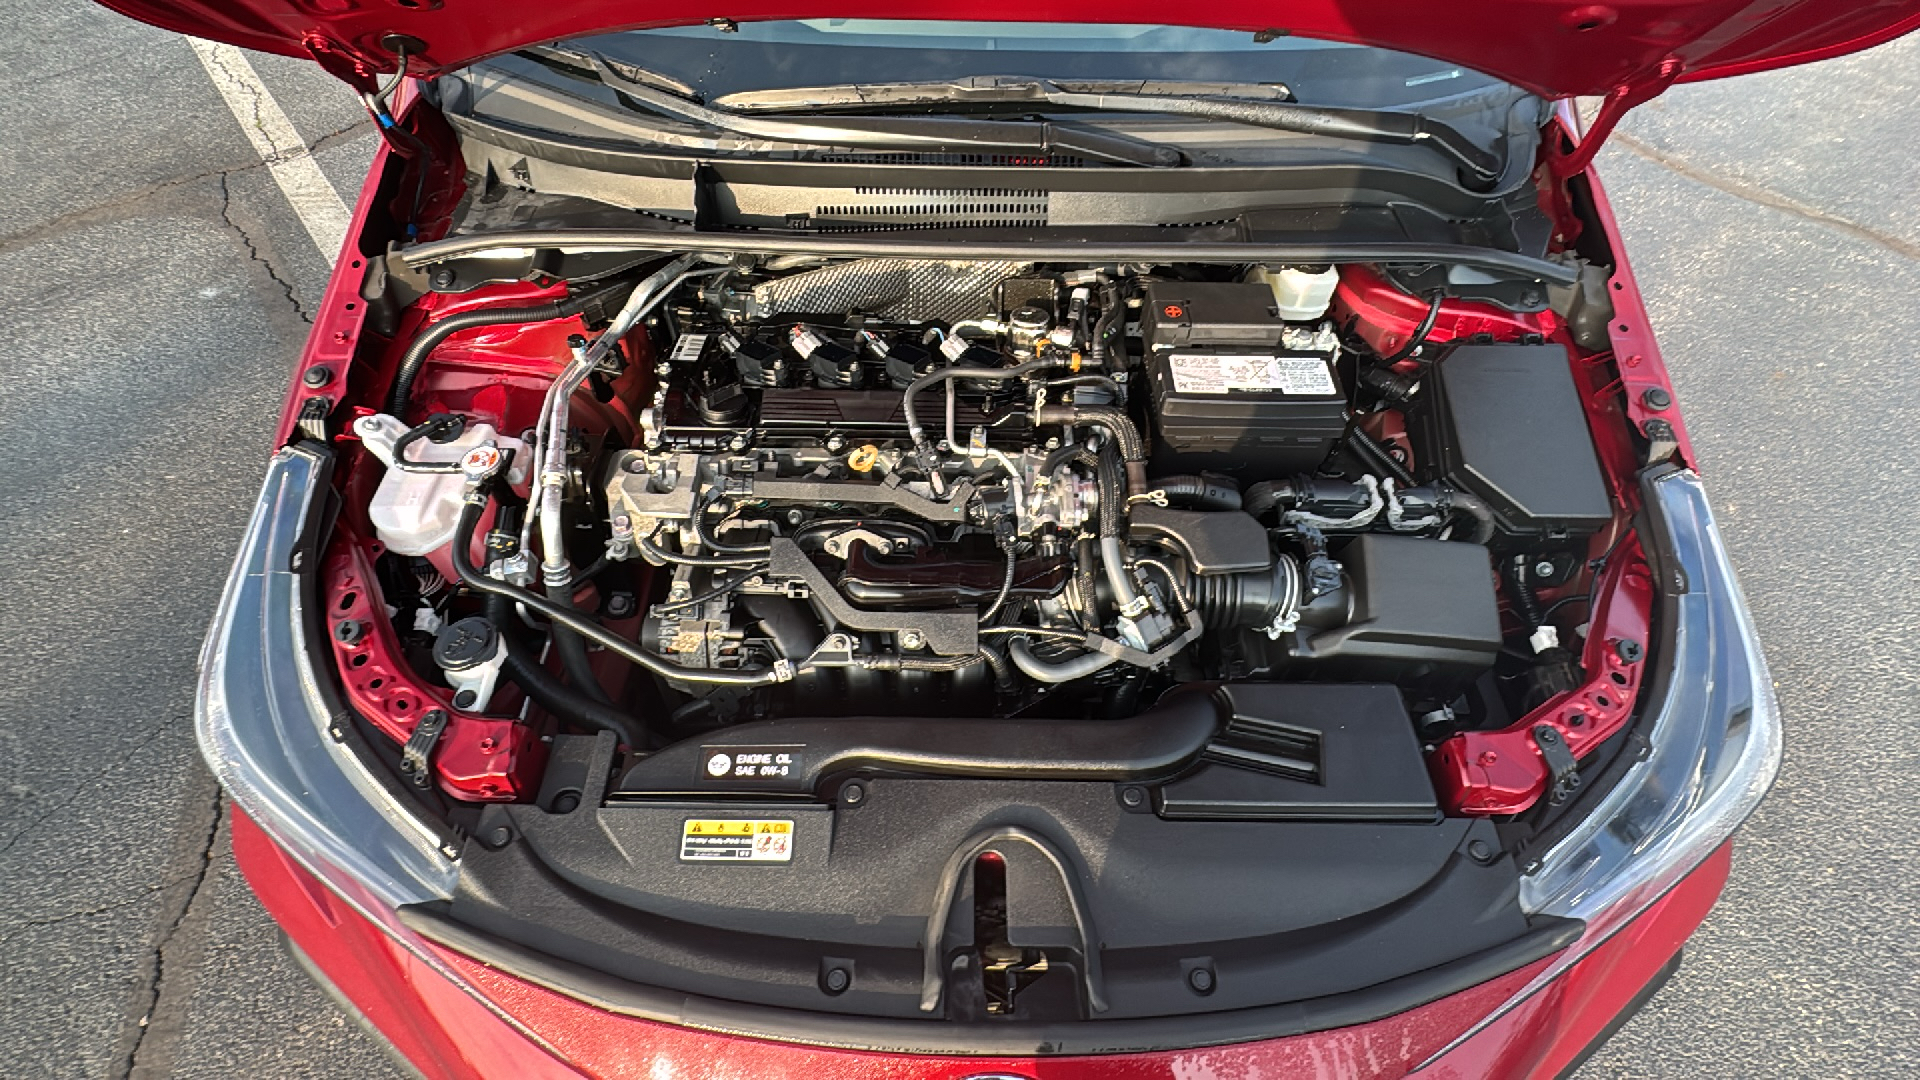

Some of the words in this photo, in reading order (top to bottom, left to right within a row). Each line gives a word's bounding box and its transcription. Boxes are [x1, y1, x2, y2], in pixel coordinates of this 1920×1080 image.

[736, 754, 772, 764] ENGINE
[776, 754, 793, 764] OIL
[735, 766, 756, 776] SAE
